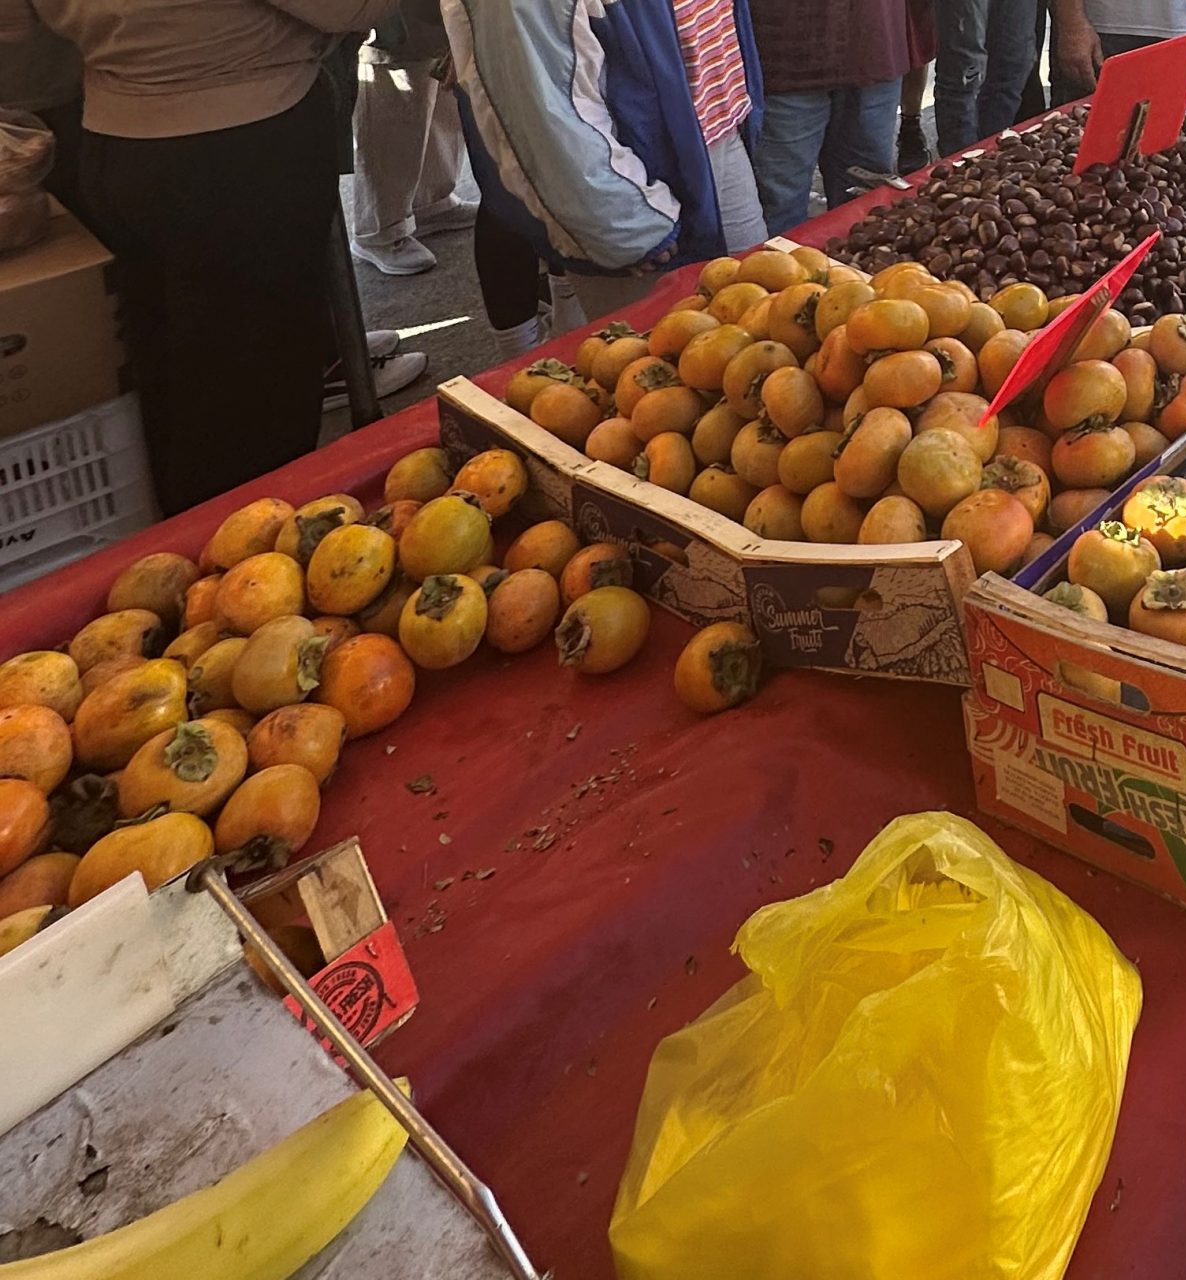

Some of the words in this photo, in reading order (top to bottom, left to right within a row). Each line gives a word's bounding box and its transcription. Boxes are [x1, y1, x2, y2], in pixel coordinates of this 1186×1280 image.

[767, 604, 839, 631] Summer
[787, 627, 823, 653] Fruits
[1122, 734, 1179, 773] Fruit
